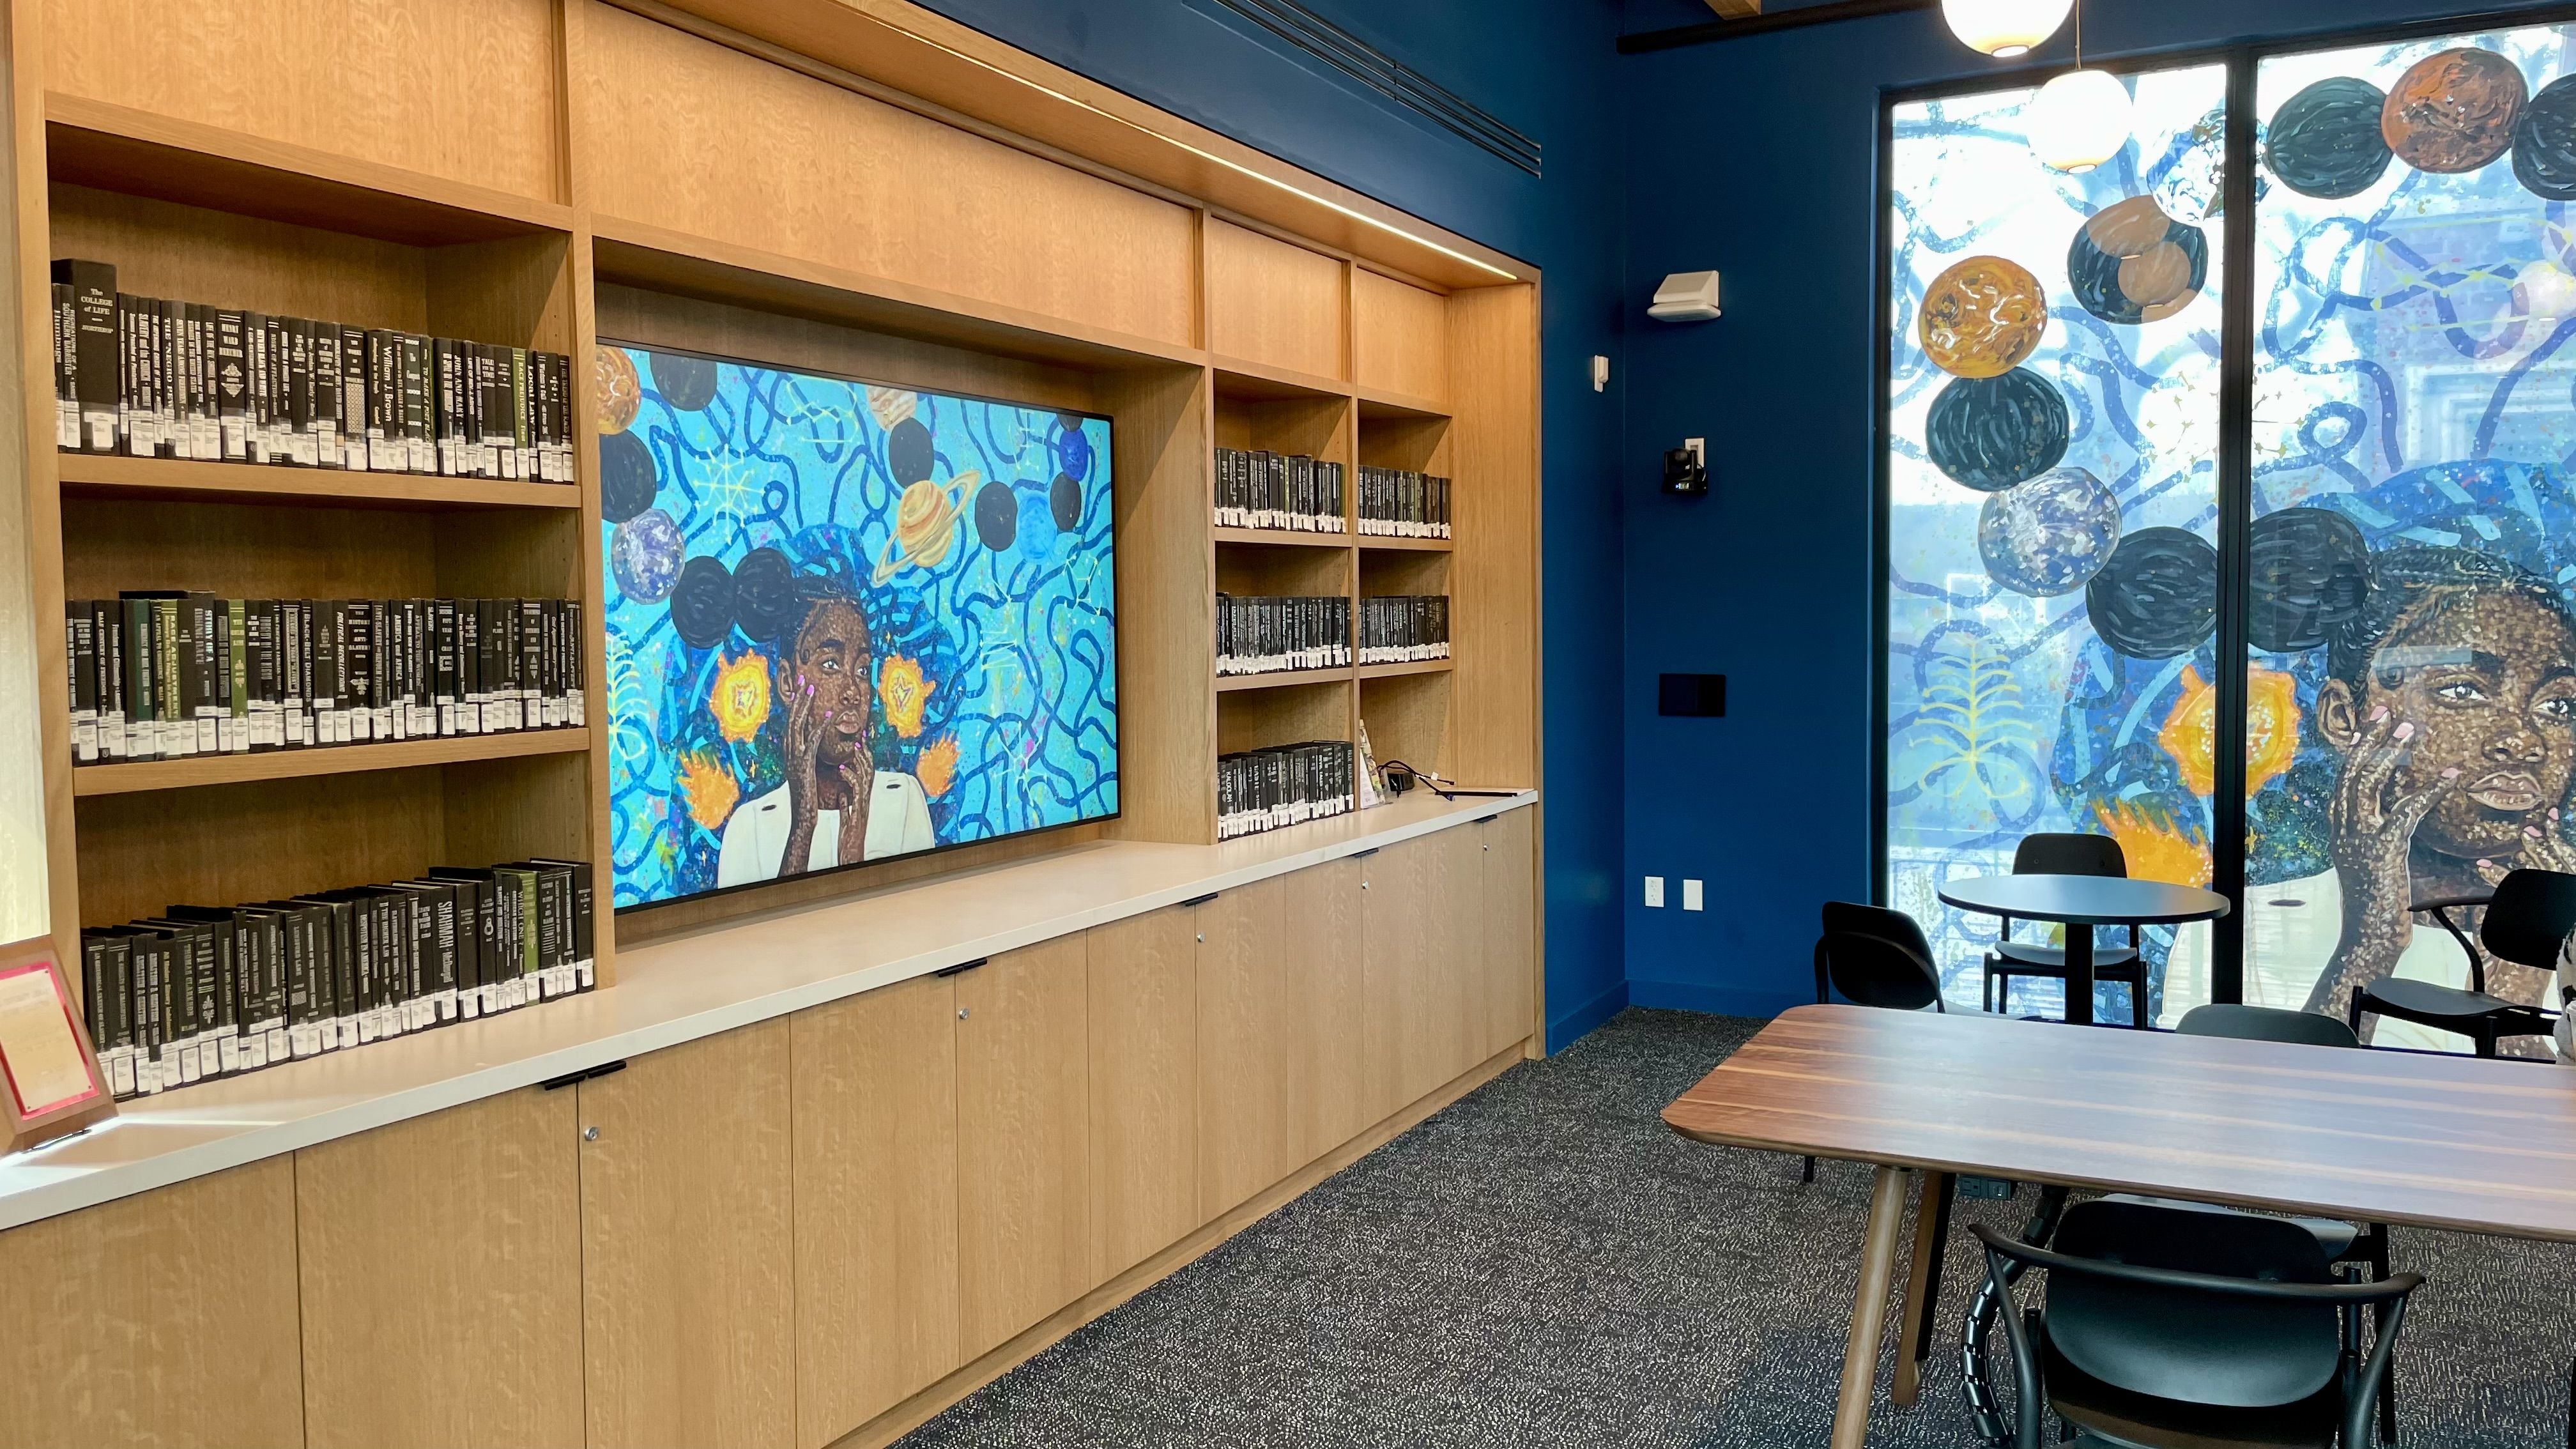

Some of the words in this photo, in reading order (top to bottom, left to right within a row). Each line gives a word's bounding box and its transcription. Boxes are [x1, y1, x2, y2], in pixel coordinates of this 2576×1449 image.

[81, 296, 112, 306] COLLEGE
[93, 307, 110, 315] LIFE
[139, 314, 149, 339] SLAVERY
[72, 355, 76, 365] OF
[383, 347, 392, 381] William
[424, 367, 428, 376] TO
[206, 642, 213, 654] OF
[438, 901, 454, 948] SHAHMAH
[185, 977, 194, 1016] CLARKSON
